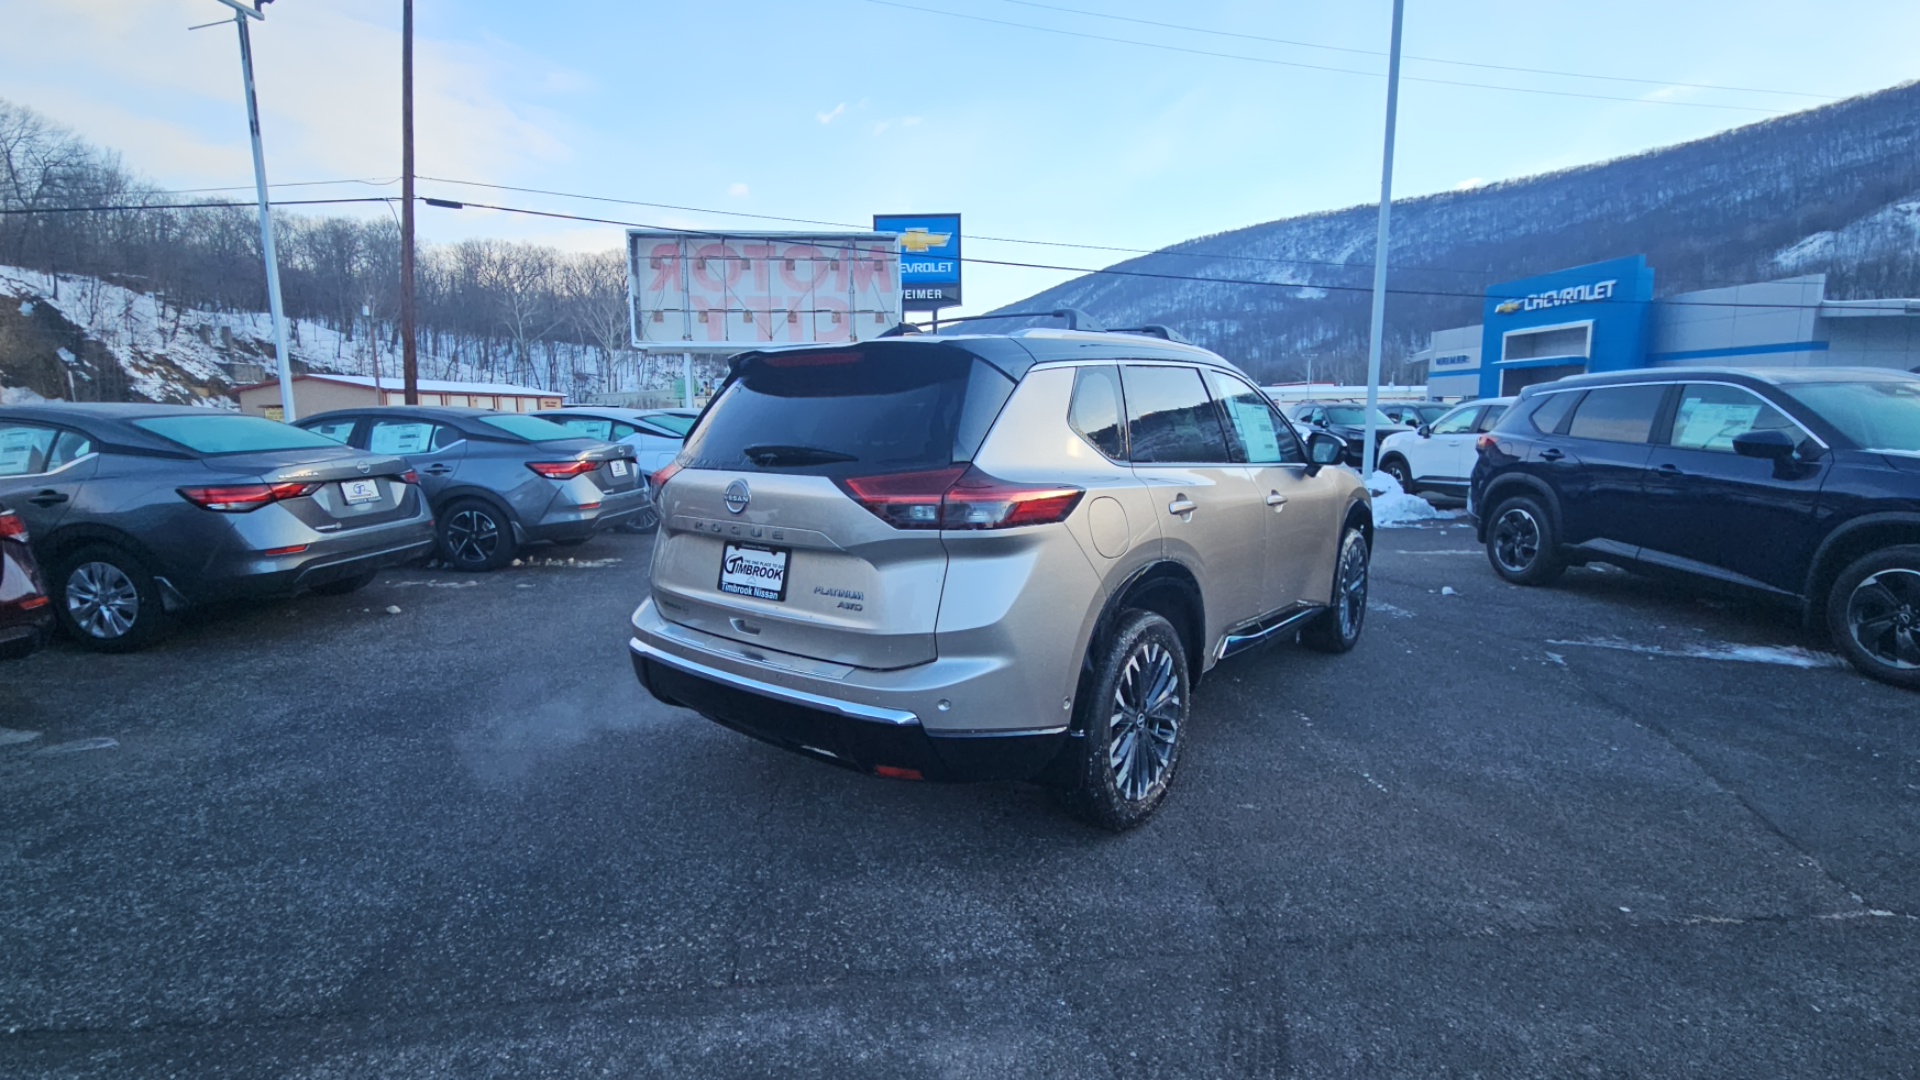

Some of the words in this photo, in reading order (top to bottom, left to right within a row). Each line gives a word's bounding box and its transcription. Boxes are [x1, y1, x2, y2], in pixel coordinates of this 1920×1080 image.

[901, 262, 954, 274] EVROLET
[1524, 279, 1617, 311] CHEVROLET
[695, 522, 783, 540] ROGUE
[725, 555, 784, 581] TIMBROOK
[722, 583, 753, 596] Timbrook
[754, 587, 778, 600] Nissan
